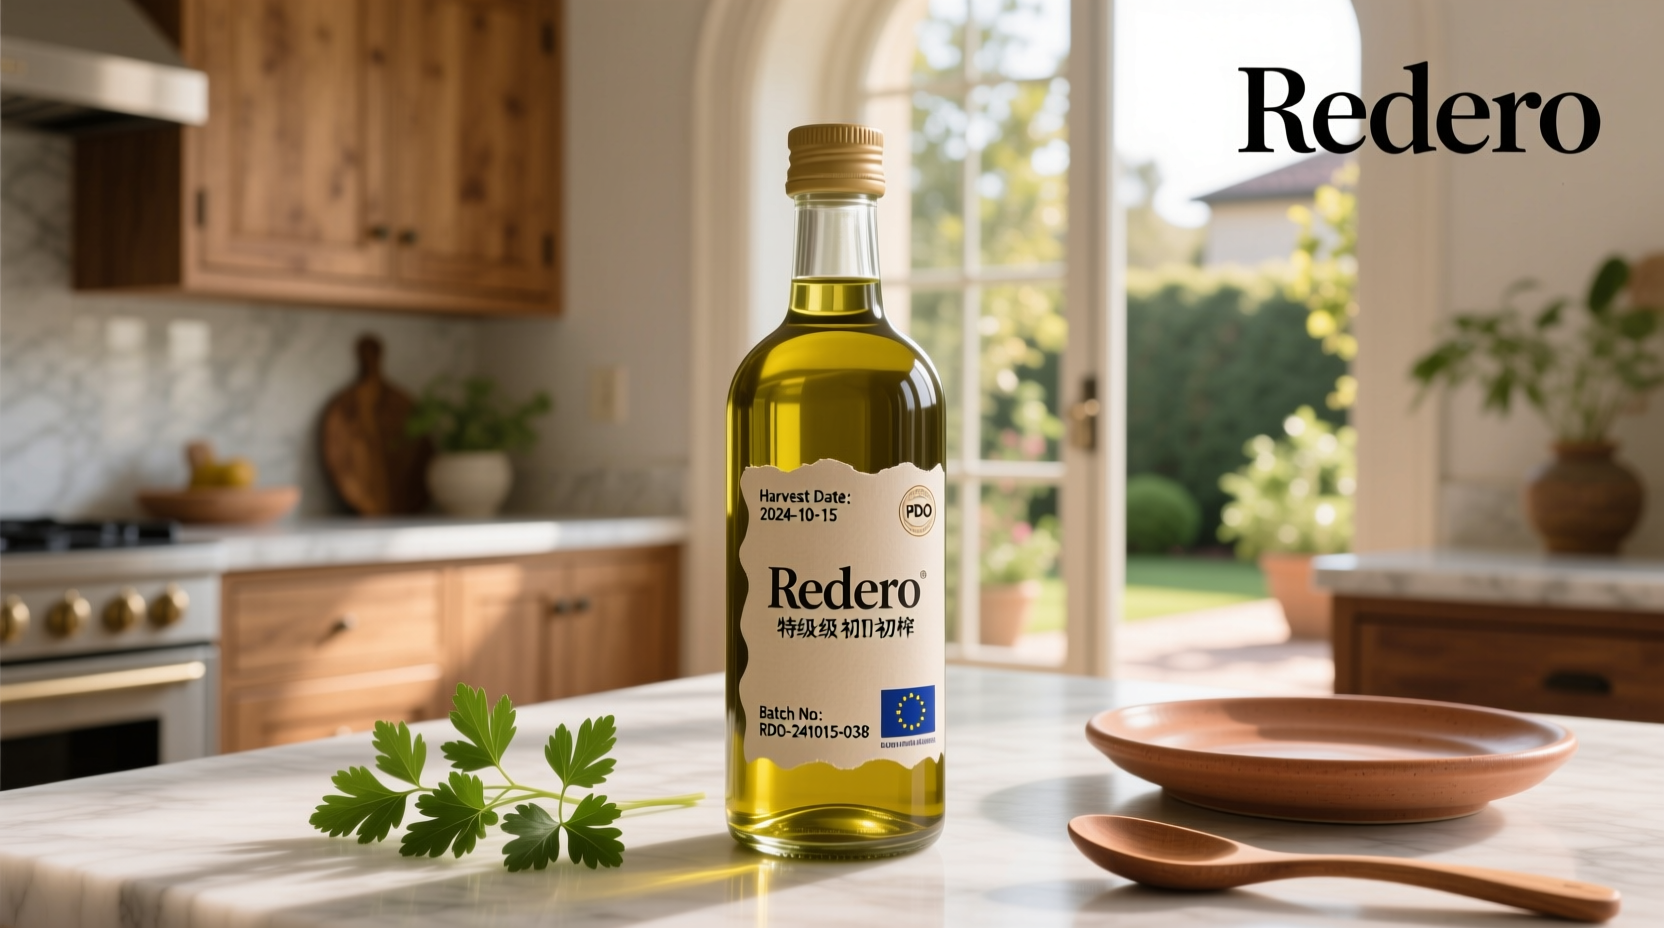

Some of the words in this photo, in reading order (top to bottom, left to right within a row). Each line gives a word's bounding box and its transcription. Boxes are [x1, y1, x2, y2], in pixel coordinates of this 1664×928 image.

[759, 489, 810, 503] Harvest
[813, 490, 851, 505] Date:
[760, 507, 838, 522] 2024-10-15
[906, 503, 933, 519] PDO
[759, 705, 795, 721] Batch
[799, 707, 823, 721] No:
